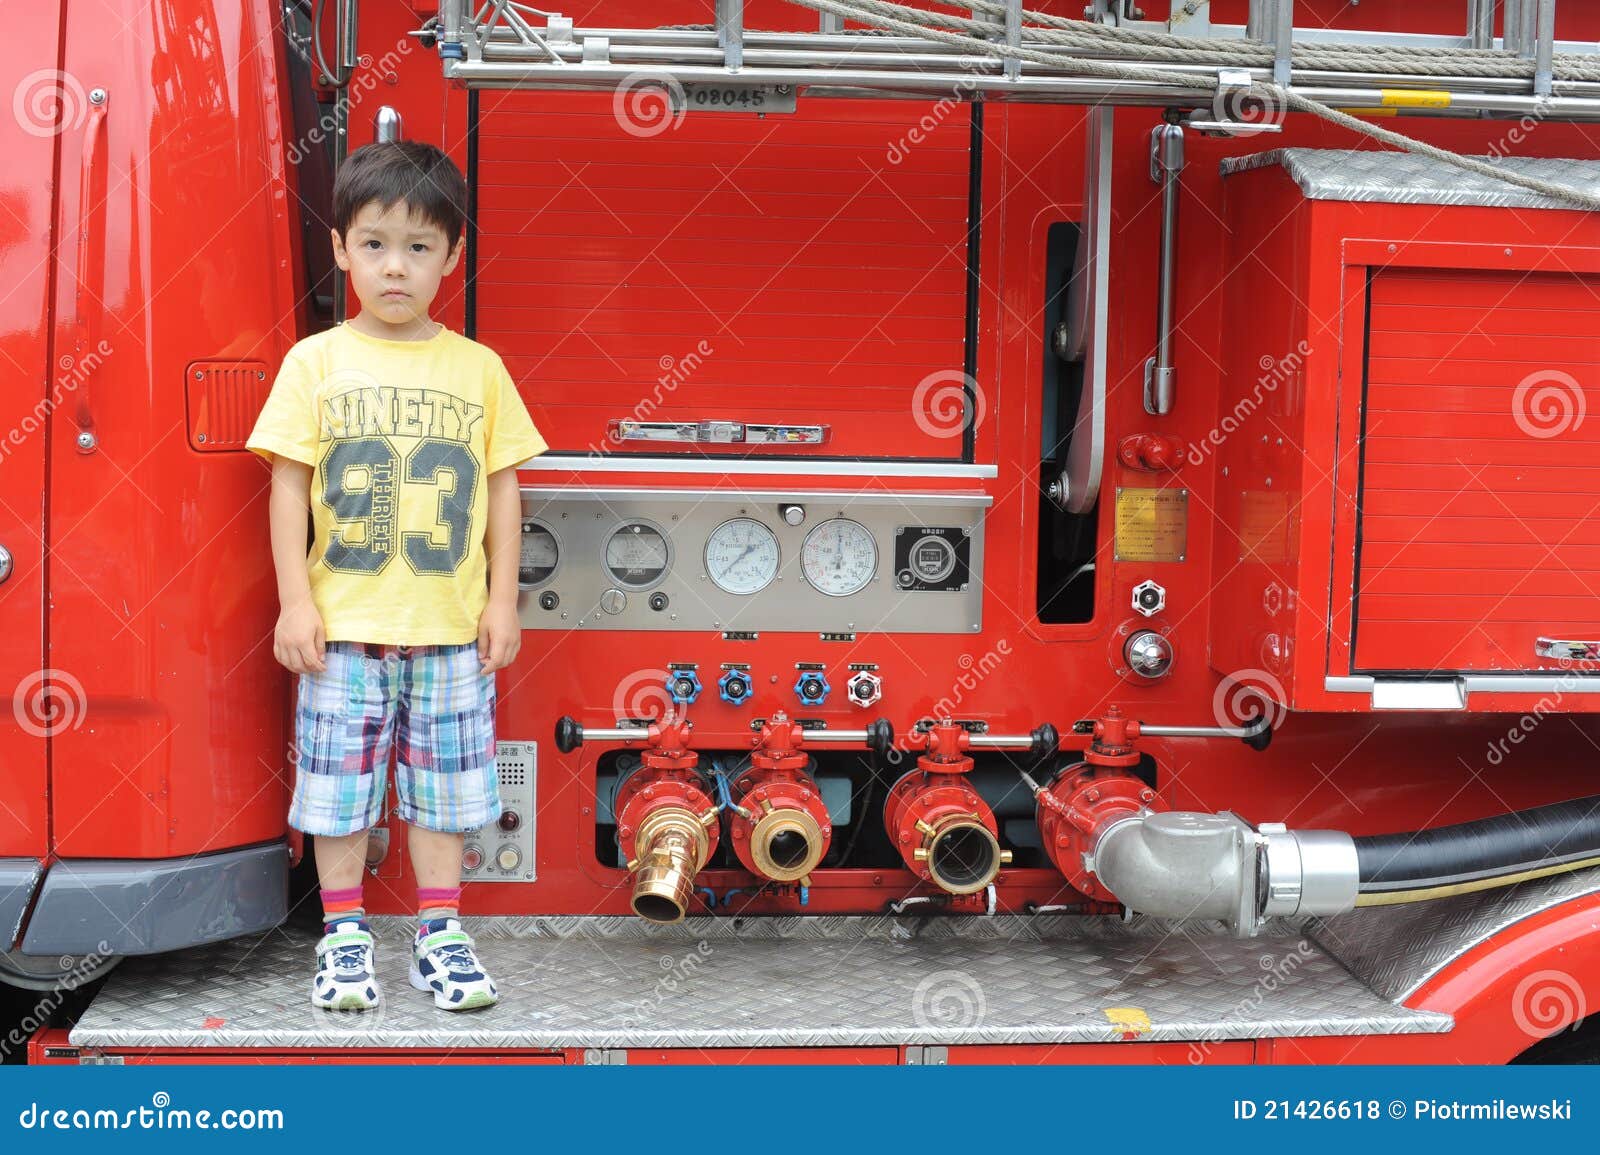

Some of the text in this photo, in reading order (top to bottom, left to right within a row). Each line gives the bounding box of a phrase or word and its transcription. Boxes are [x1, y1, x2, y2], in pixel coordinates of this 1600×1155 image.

[318, 386, 483, 443] NINETY
[319, 437, 481, 577] 93
[371, 458, 395, 553] THREE
